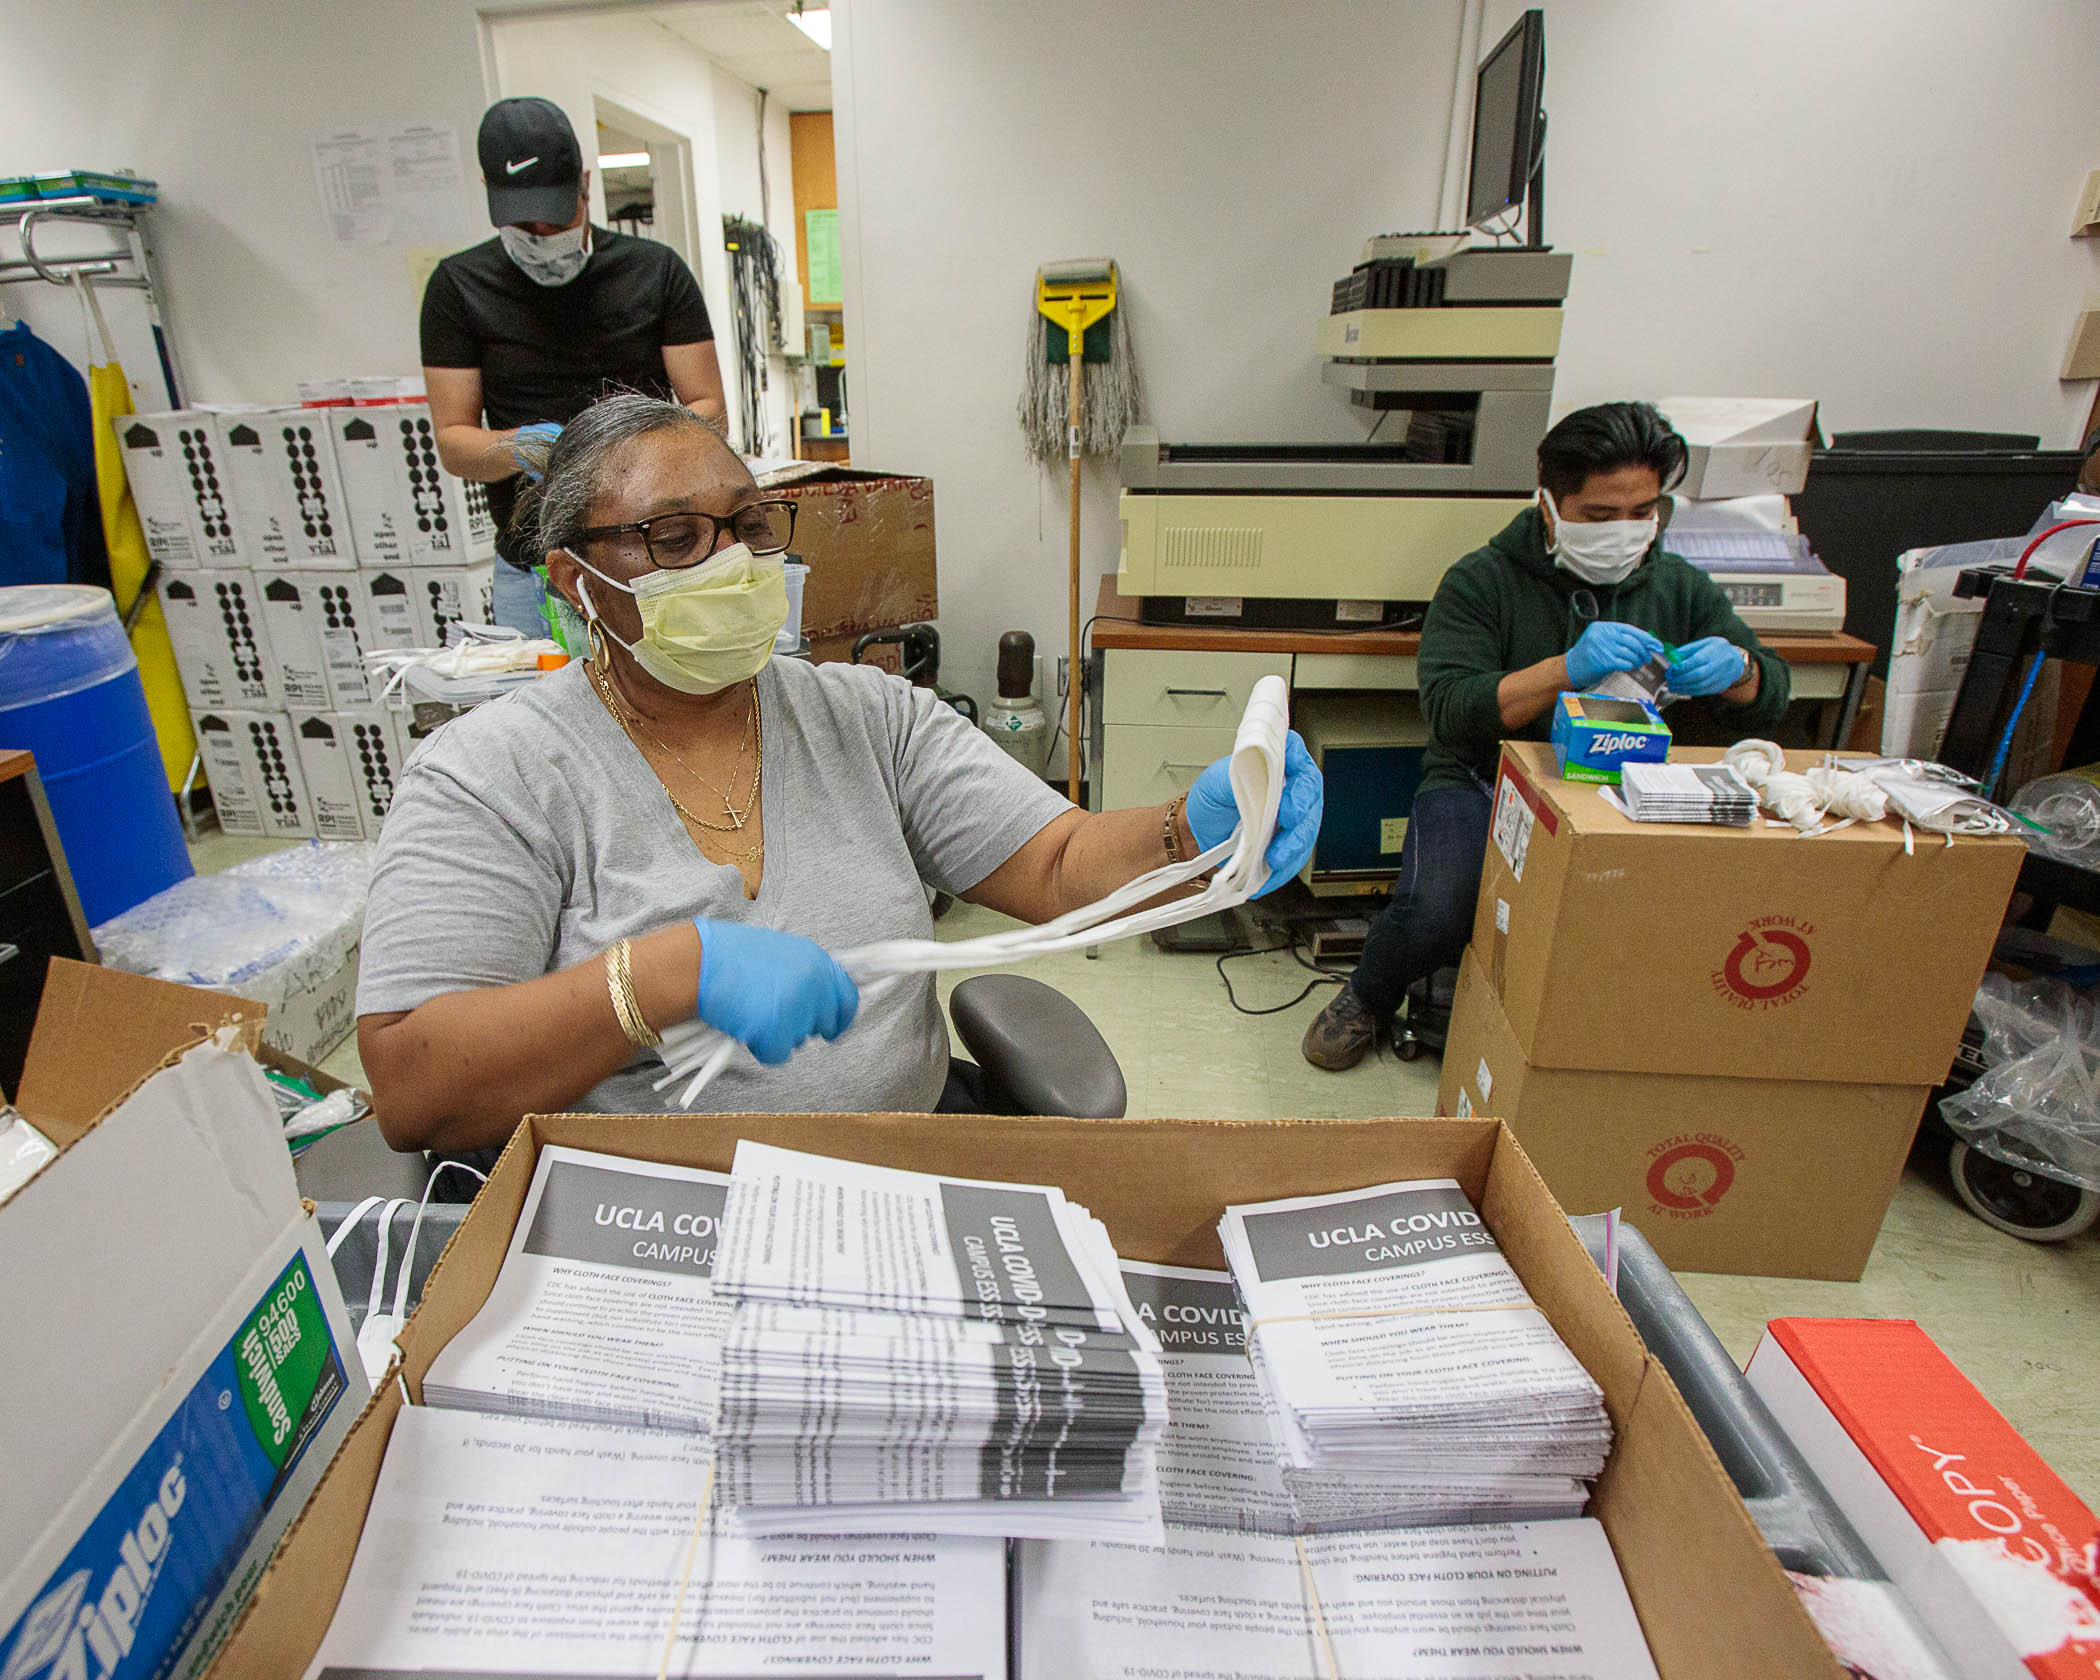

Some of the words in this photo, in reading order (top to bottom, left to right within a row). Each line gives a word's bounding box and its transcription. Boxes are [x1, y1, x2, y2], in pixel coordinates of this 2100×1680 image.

[1588, 733, 1648, 756] Ziploc
[1566, 772, 1609, 781] SANDWICH
[594, 1203, 665, 1233] UCLA
[990, 1216, 1024, 1253] UCLA
[1308, 1223, 1386, 1249] UCLA
[633, 1240, 717, 1267] CAMPUS
[1365, 1235, 1457, 1263] CAMPUS
[963, 1235, 995, 1280] CAMPUS
[553, 1267, 572, 1276] WHY
[573, 1269, 599, 1279] CLOTH
[600, 1273, 619, 1282] FACE
[621, 1275, 672, 1287] COVERINGS?
[1301, 1282, 1322, 1290] WHY
[1323, 1280, 1350, 1288] CLOTH
[1352, 1278, 1371, 1286] FACE
[1374, 1270, 1426, 1283] COVERINGS?
[1411, 1281, 1438, 1290] CLOTH
[1440, 1278, 1459, 1286] FACE
[259, 1270, 305, 1337] 94600
[648, 1292, 673, 1301] CLOTH
[675, 1296, 694, 1304] FACE
[268, 1307, 298, 1354] 500
[1456, 1363, 1479, 1371] FACE
[240, 1328, 292, 1445] Sandwich
[1180, 1422, 1210, 1430] THEM?
[1186, 1468, 1207, 1476] FACE
[761, 1552, 797, 1564] THEM?
[800, 1552, 831, 1563] WEAR
[834, 1552, 857, 1563] YOU
[859, 1552, 901, 1563] SHOULD
[903, 1552, 936, 1563] WHEN
[1408, 1572, 1431, 1582] FACE
[1433, 1571, 1465, 1581] CLOTH
[1466, 1570, 1494, 1580] YOUR
[1497, 1569, 1512, 1579] ON
[1514, 1567, 1557, 1578] PUTTING
[1412, 1647, 1448, 1658] THEM?
[1450, 1647, 1481, 1656] WEAR
[1483, 1646, 1505, 1656] YOU
[1507, 1645, 1549, 1656] SHOULD
[1550, 1644, 1583, 1655] WHEN
[763, 1655, 834, 1665] COVERINGS?
[836, 1655, 863, 1664] FACE
[866, 1655, 903, 1664] CLOTH
[906, 1655, 932, 1664] WHY
